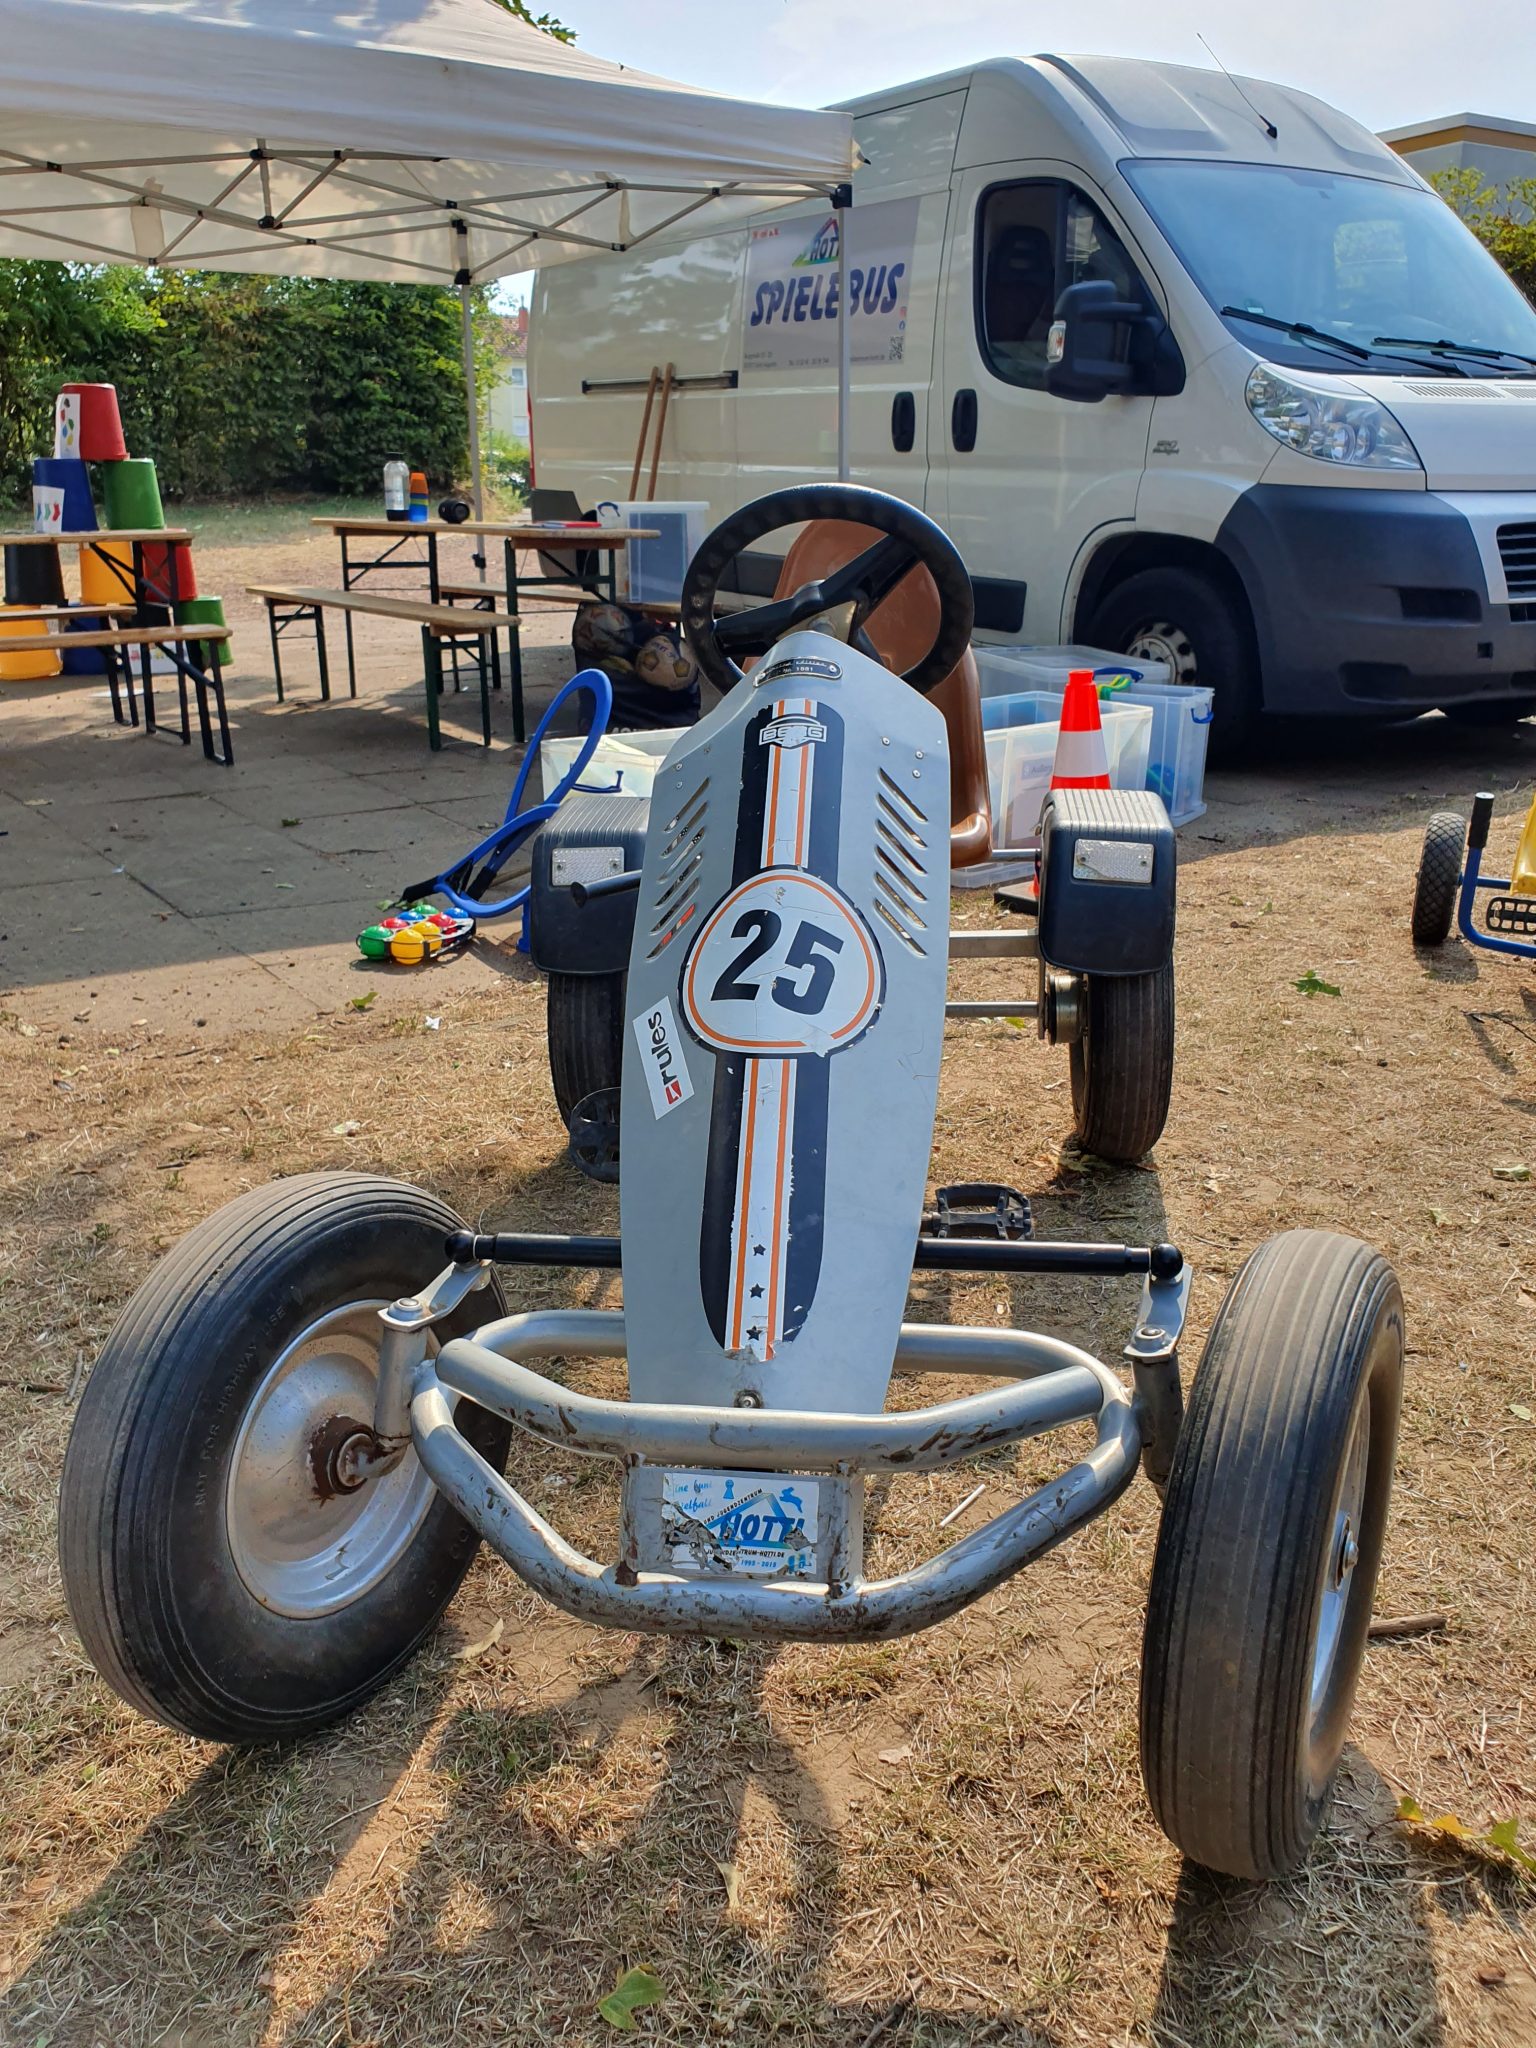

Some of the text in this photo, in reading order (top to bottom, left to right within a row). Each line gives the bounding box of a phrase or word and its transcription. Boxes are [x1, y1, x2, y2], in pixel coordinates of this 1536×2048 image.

[710, 909, 844, 1016] 25
[648, 1011, 678, 1086] rules
[194, 1470, 209, 1506] NOT
[202, 1422, 221, 1460] FOR
[216, 1343, 258, 1415] HIGHWAY
[716, 1488, 764, 1518] JUGENDZENTRUM
